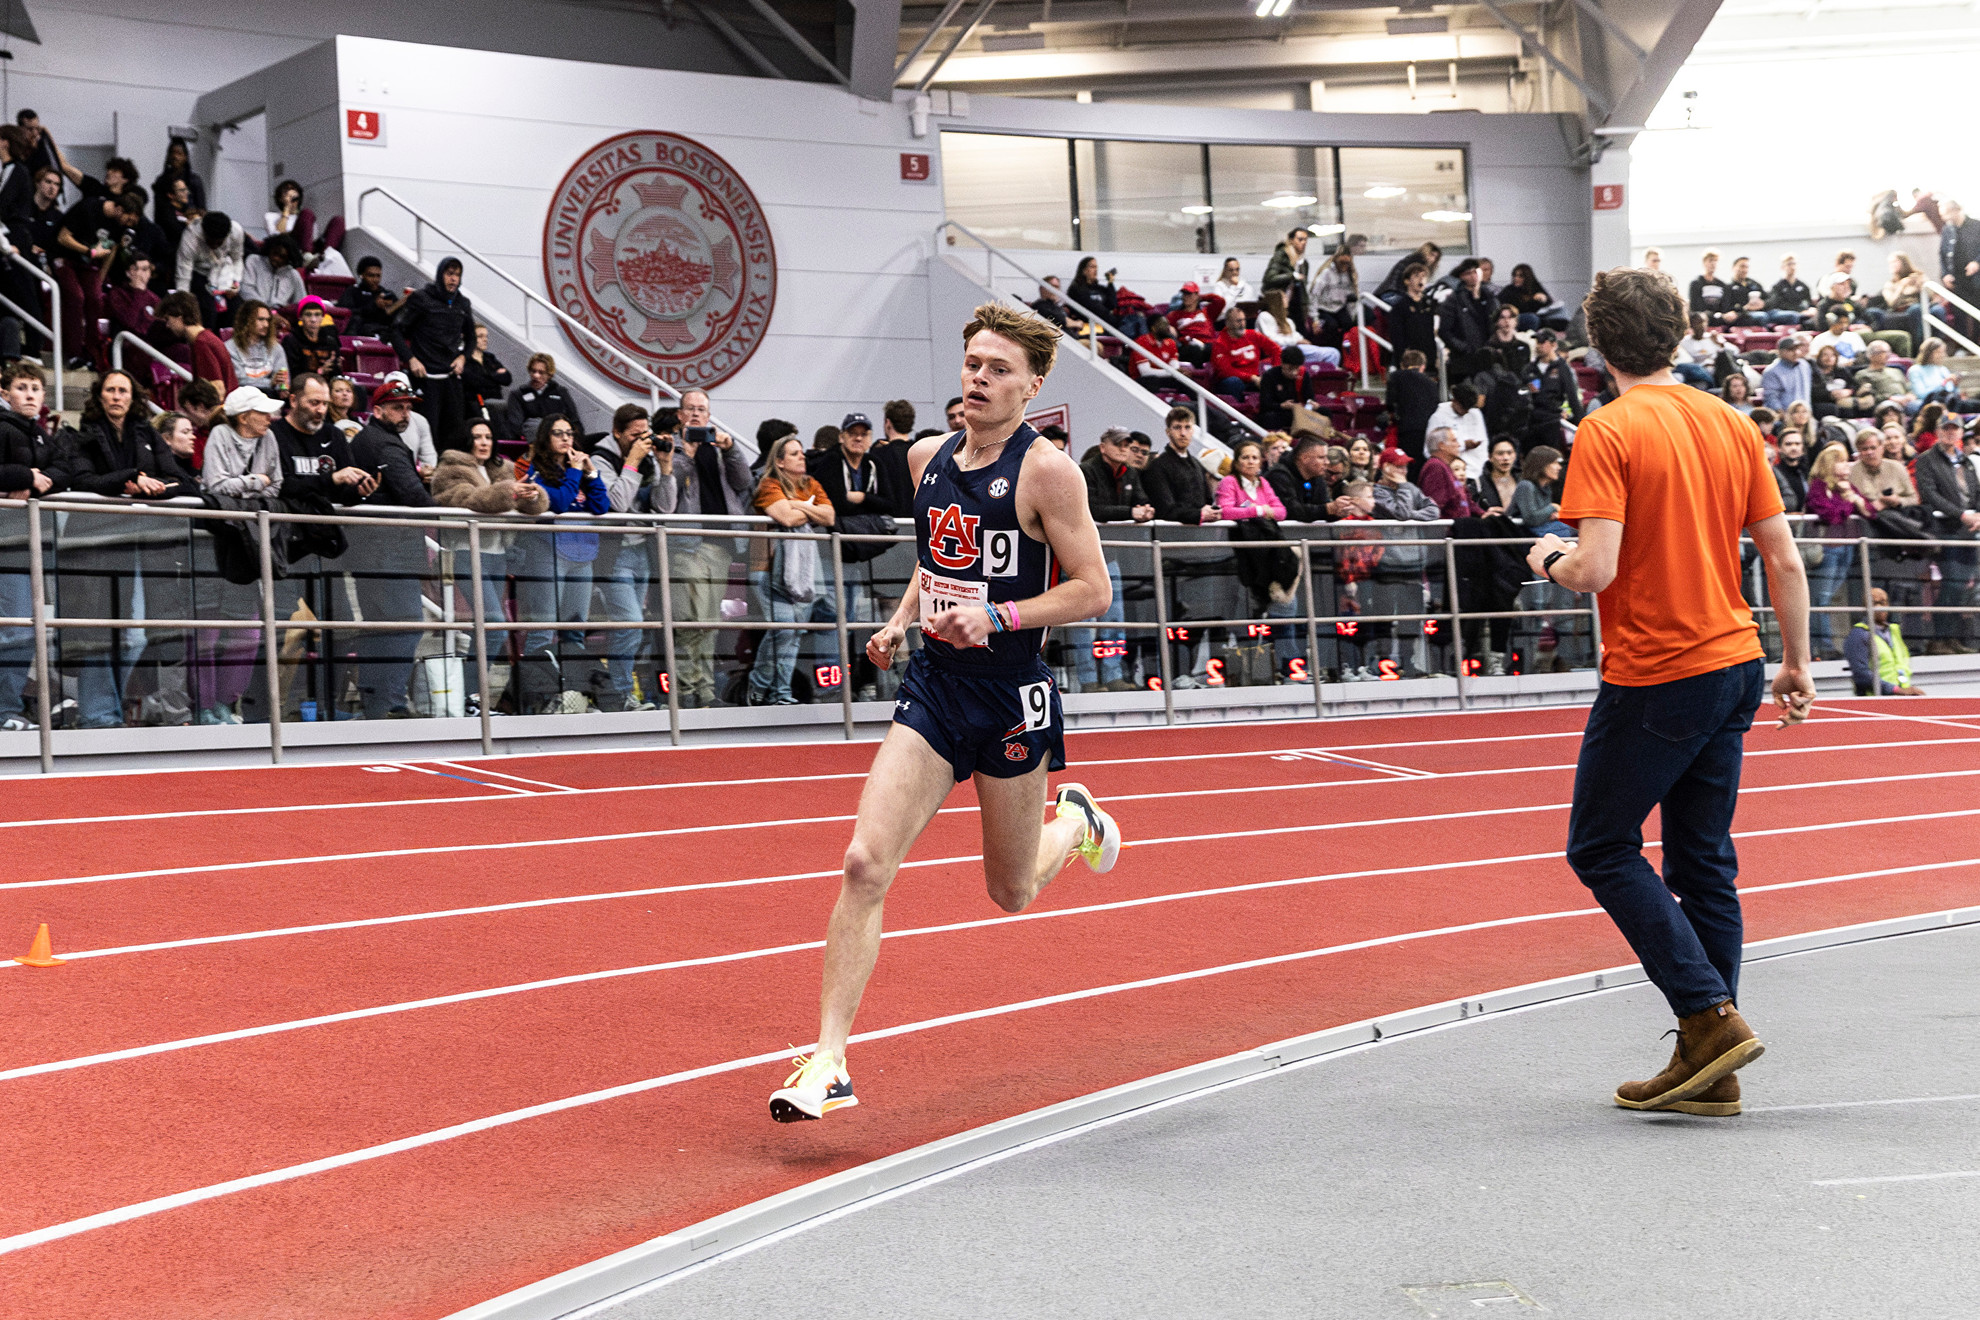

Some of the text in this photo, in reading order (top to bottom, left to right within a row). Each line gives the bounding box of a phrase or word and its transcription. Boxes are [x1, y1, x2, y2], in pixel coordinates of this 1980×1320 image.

[357, 113, 368, 130] 4
[910, 156, 919, 171] 5
[554, 142, 768, 264] UNIVERSITAS BOSTONIENSIS
[291, 456, 320, 475] IUP
[989, 478, 1009, 497] SEC
[991, 532, 1011, 574] 9
[1029, 685, 1046, 728] 9
